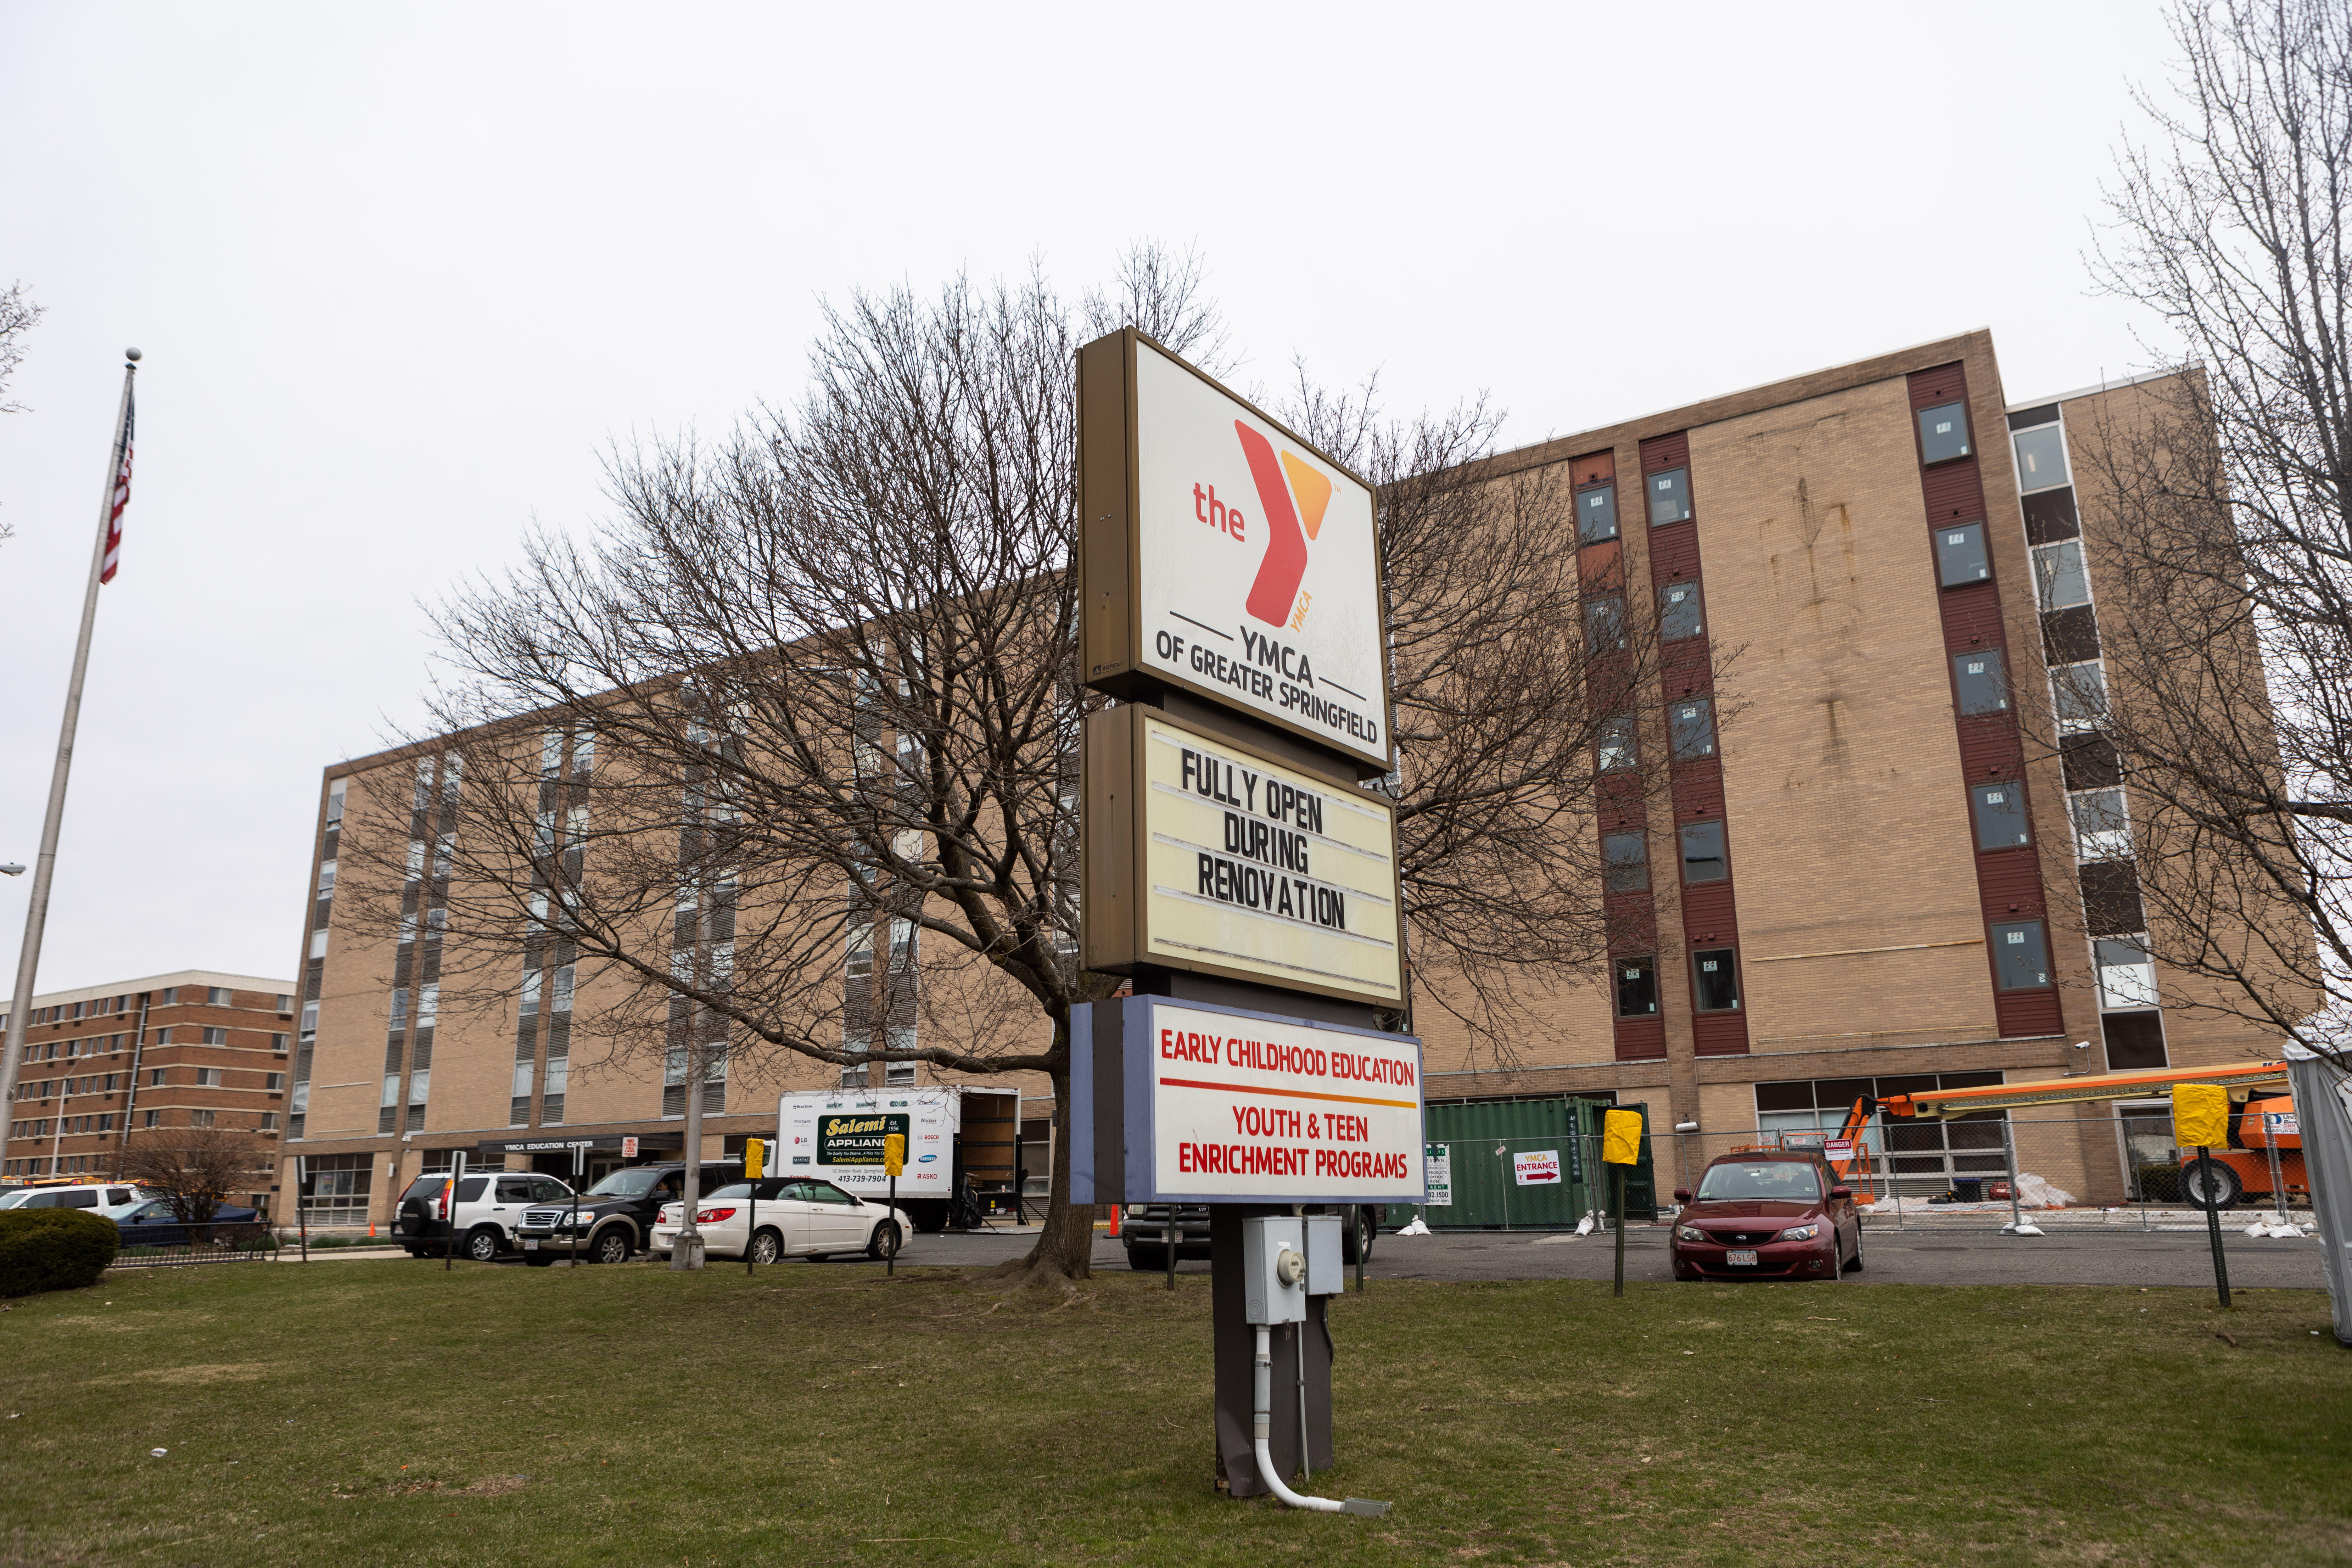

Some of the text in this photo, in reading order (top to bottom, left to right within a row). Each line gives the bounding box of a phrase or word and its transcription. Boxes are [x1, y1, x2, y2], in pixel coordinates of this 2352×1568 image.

[1193, 482, 1245, 542] the
[1290, 590, 1312, 633] YMCA
[1103, 661, 1122, 671] AGNOLI
[1240, 625, 1314, 689] YMCA
[1157, 631, 1377, 744] OF GREATER SPRINGFIELD
[1182, 748, 1322, 835] FULLY OPEN
[1225, 811, 1309, 874] DURING
[1198, 852, 1345, 930] RENOVATION
[1161, 1029, 1415, 1087] EARLY CHILDHOOD EDUCATION
[527, 1142, 564, 1150] EDUCATION
[826, 1116, 886, 1136] Salemi
[1232, 1106, 1368, 1142] YOUTH & TEEN
[1179, 1142, 1407, 1179] ENRICHMENT PROGRAMS
[1517, 1162, 1558, 1171] ENTRANCE
